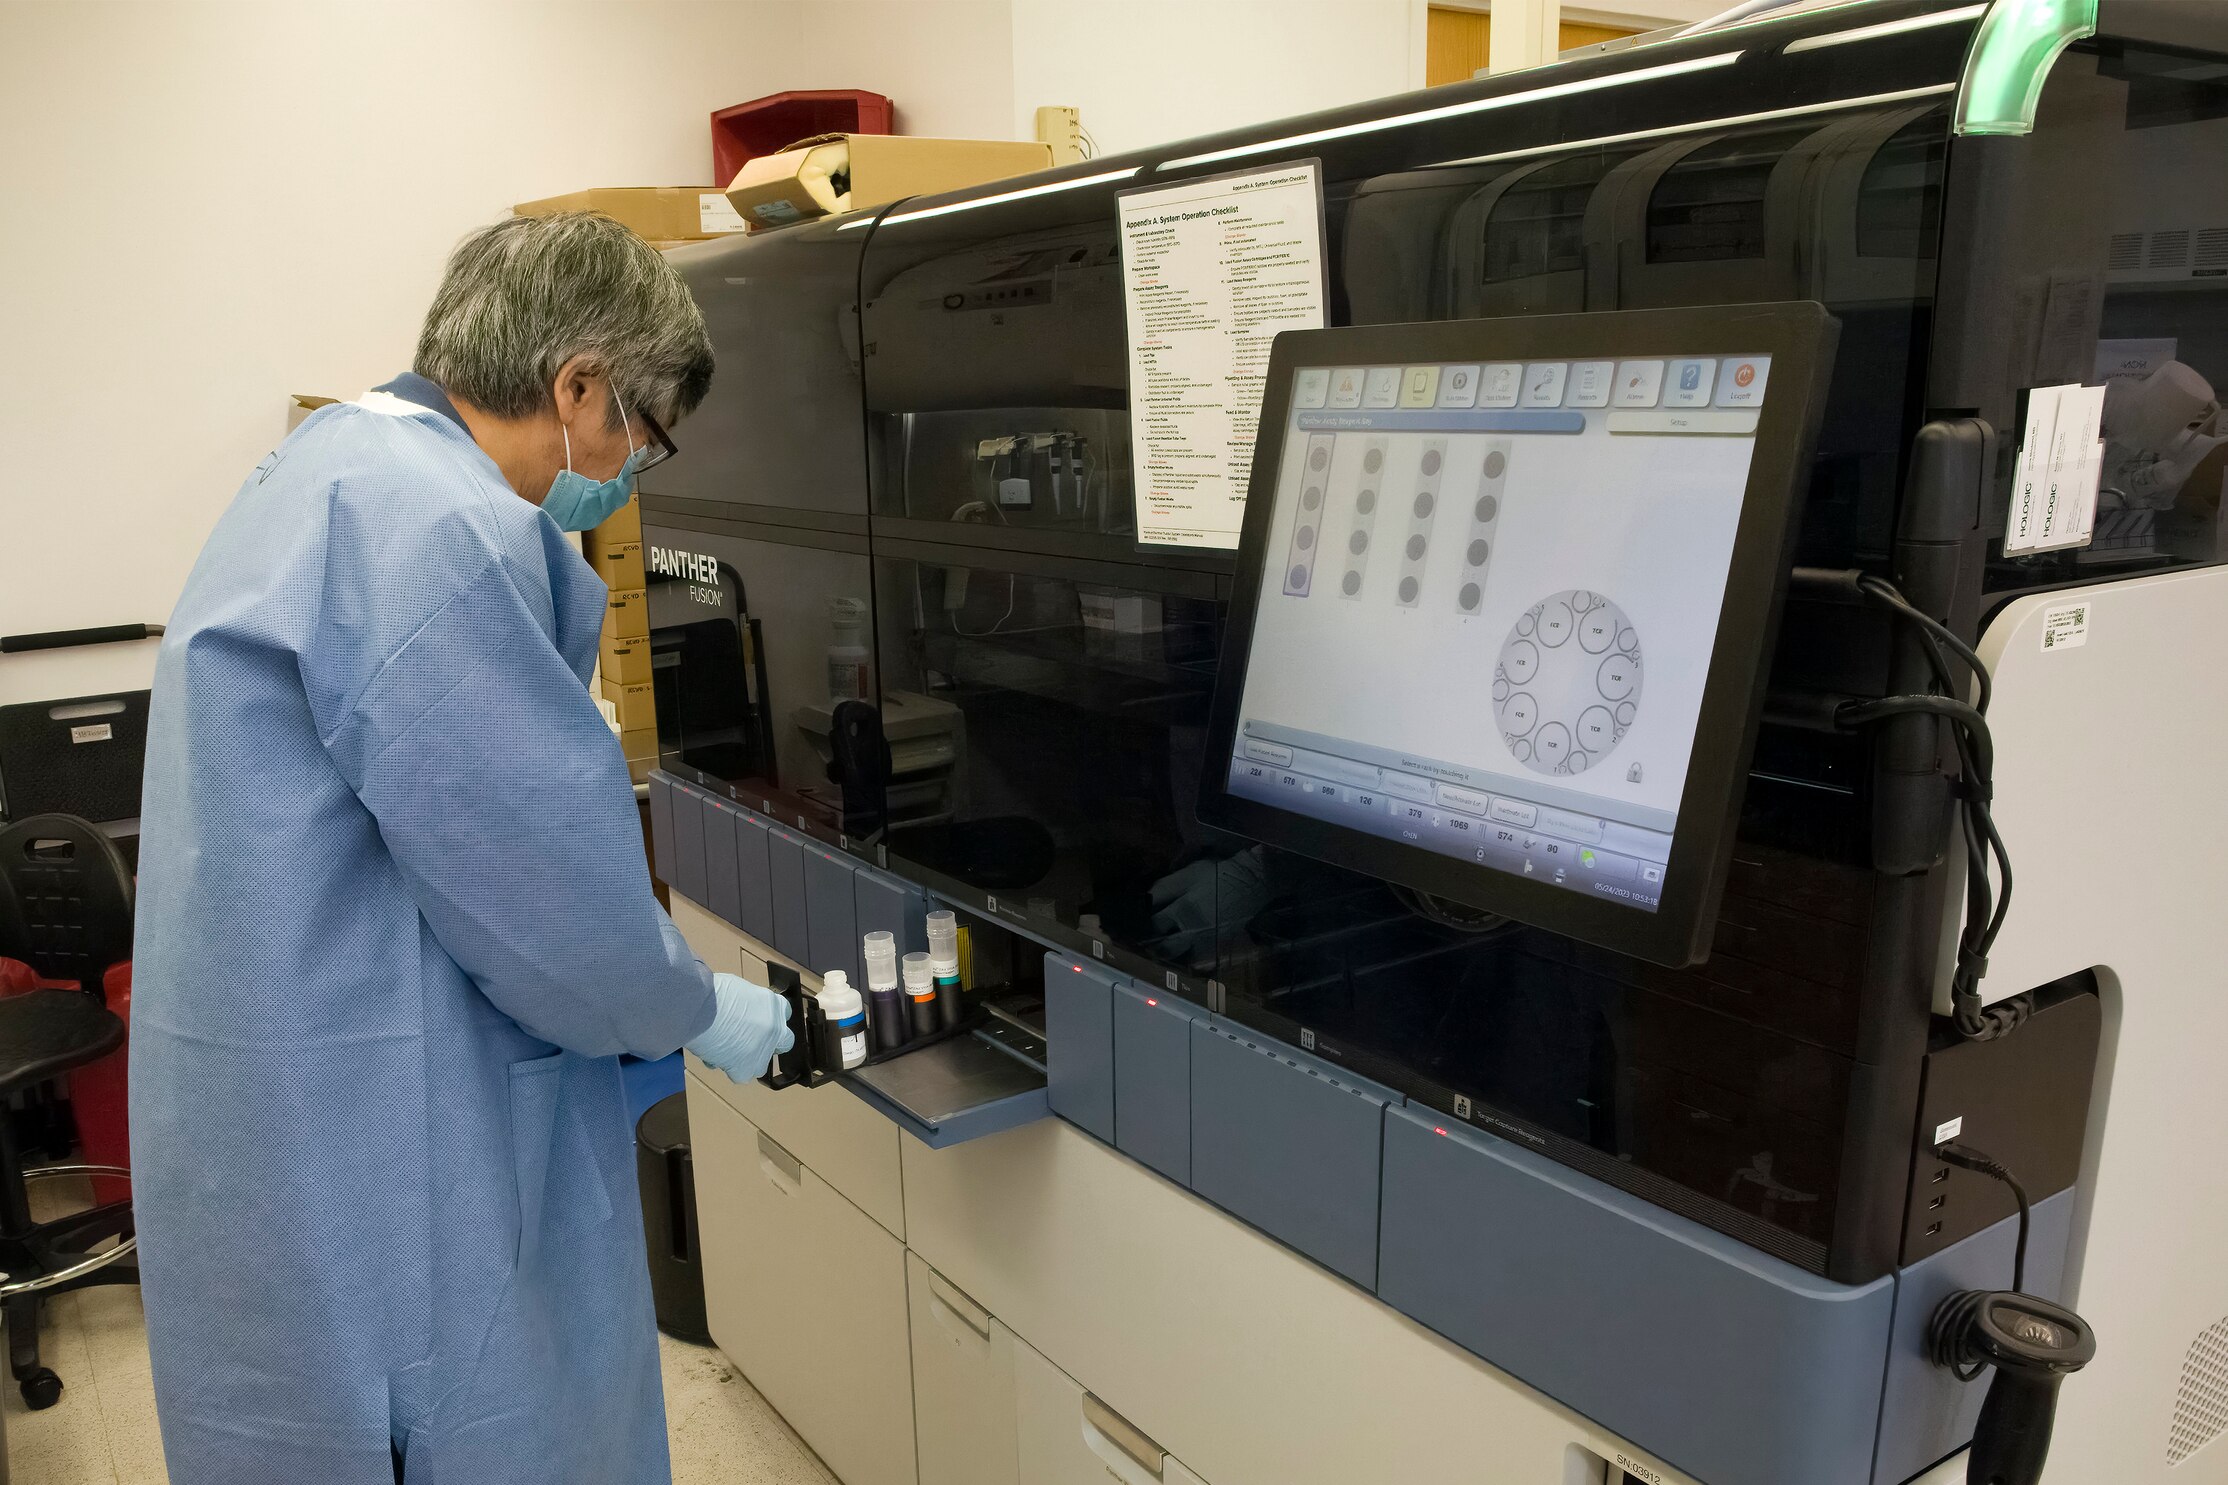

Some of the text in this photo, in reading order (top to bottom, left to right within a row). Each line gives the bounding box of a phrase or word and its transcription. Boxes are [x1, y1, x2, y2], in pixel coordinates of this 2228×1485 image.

[1126, 218, 1152, 229] Appendix
[1160, 214, 1181, 225] System
[1181, 210, 1210, 221] Operation
[1211, 206, 1239, 216] Checklist
[1730, 392, 1752, 400] Logoff
[1670, 418, 1688, 426] Setup
[2020, 482, 2032, 538] HOLOGIC
[2043, 483, 2057, 538] HOLOGIC
[650, 546, 719, 586] PANTHER
[1402, 759, 1416, 768] Select
[1433, 767, 1439, 775] by
[1440, 769, 1464, 780] touching
[1408, 808, 1422, 818] 379
[1449, 819, 1469, 830] 1069
[1498, 831, 1513, 841] 574
[1594, 882, 1658, 906] 05/24/2023 10:53:18
[1477, 1111, 1545, 1144] Target Capture Reagents
[1616, 1454, 1661, 1485] SN:03912
